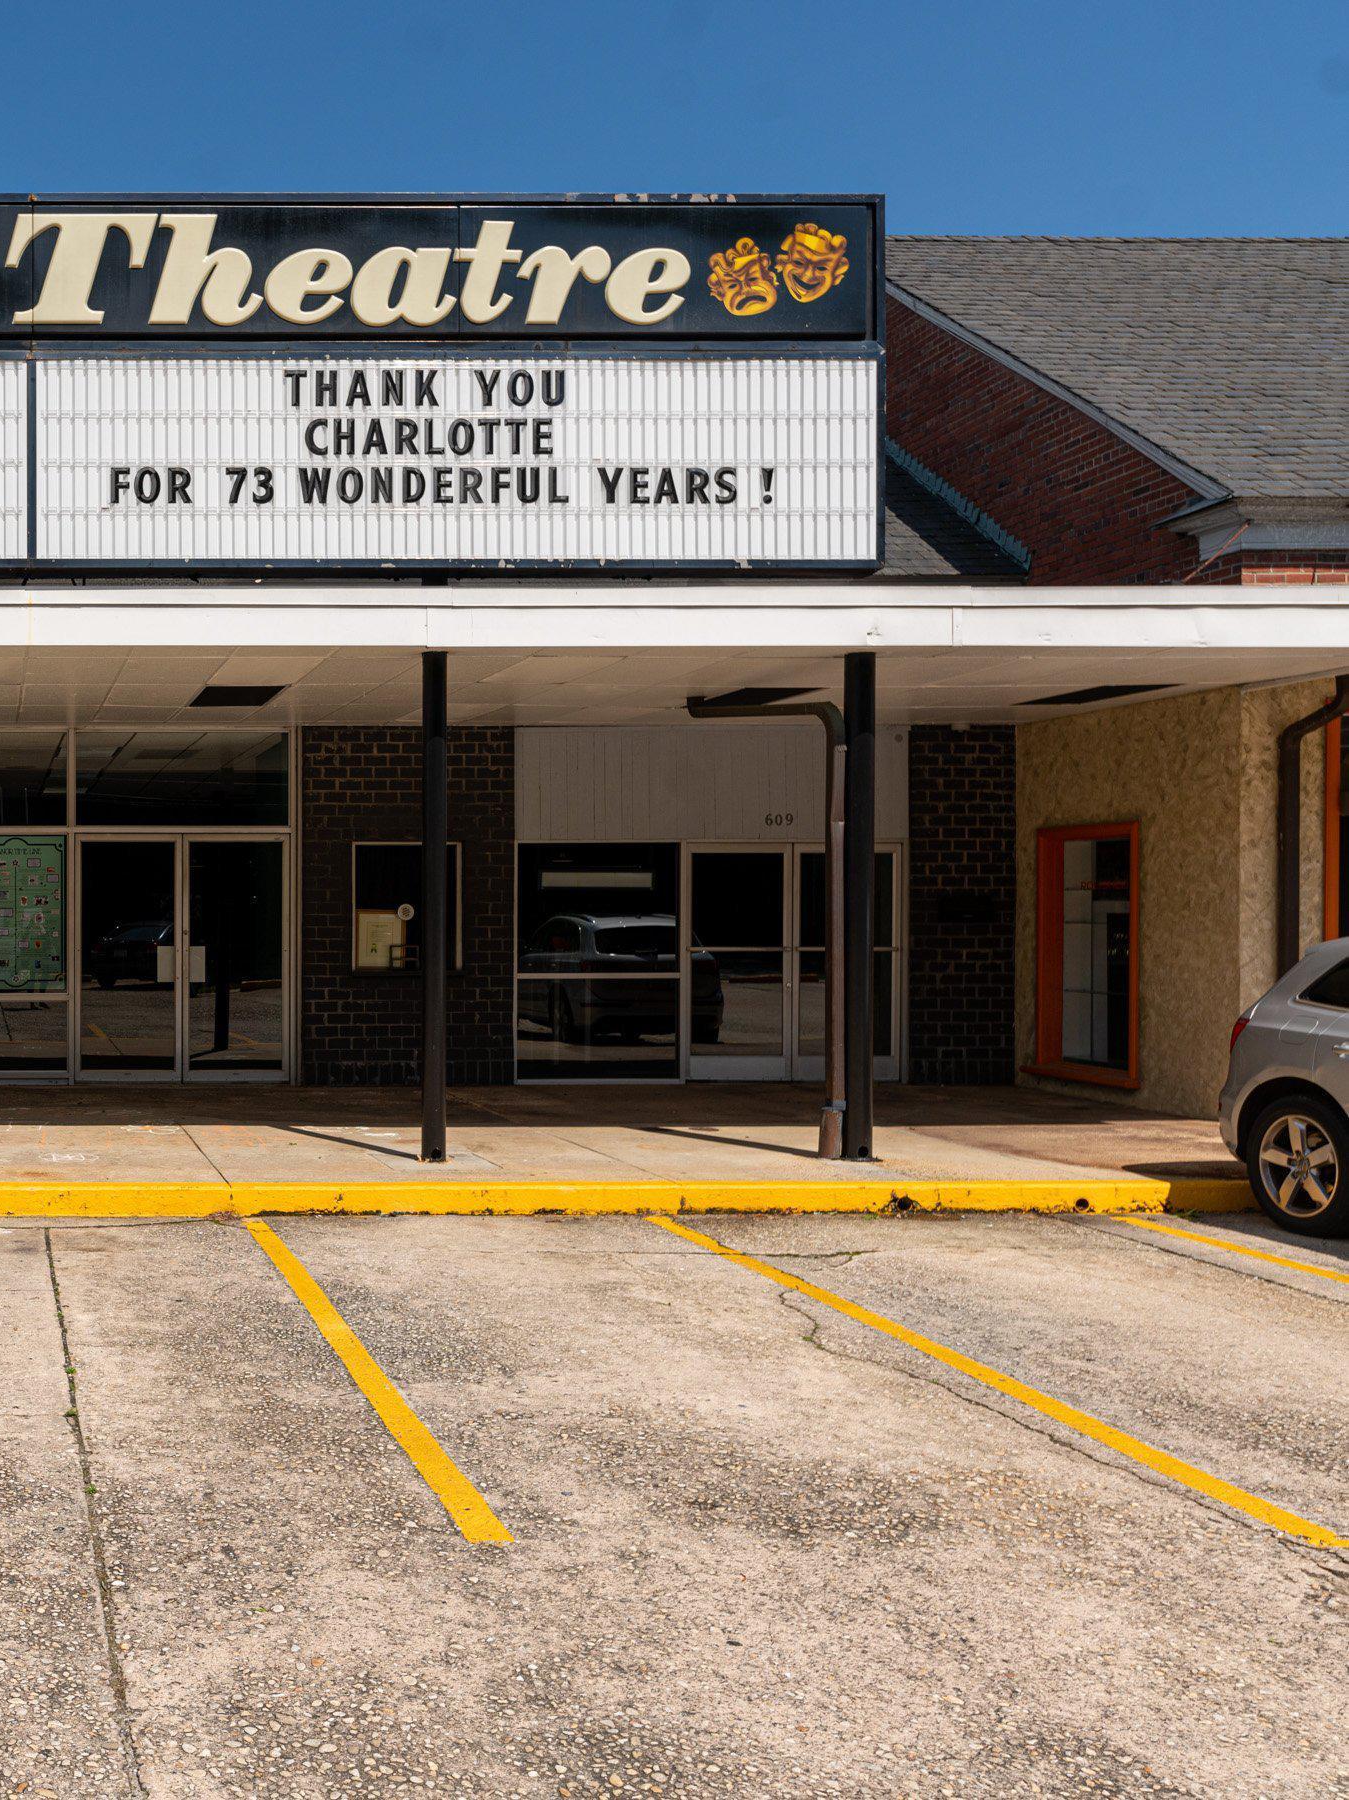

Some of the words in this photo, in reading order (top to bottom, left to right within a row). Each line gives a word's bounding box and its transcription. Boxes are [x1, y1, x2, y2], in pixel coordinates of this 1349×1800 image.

[4, 212, 692, 326] Theatre
[284, 369, 440, 408] THANK
[473, 369, 565, 408] YOU
[304, 418, 554, 457] CHARLOTTE
[110, 466, 194, 505] FOR
[225, 466, 275, 505] 73
[298, 466, 569, 505] WONDERFUL
[764, 812, 794, 827] 609
